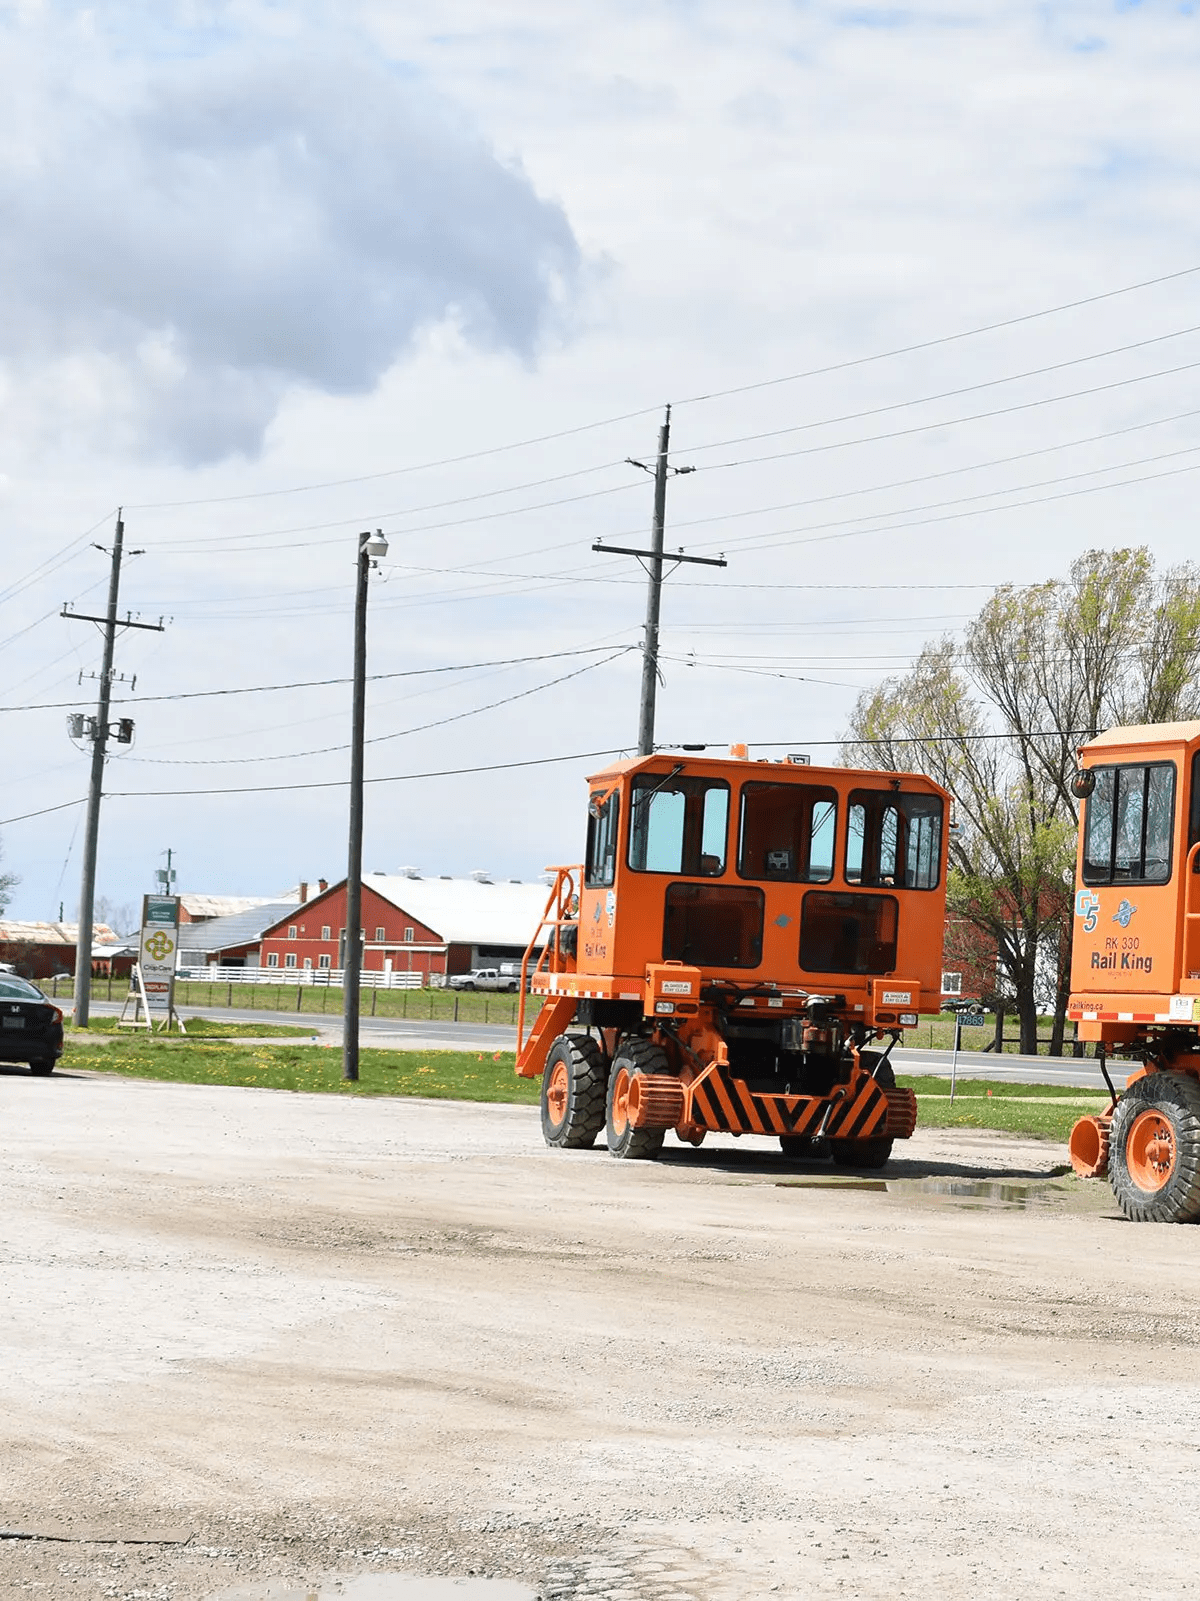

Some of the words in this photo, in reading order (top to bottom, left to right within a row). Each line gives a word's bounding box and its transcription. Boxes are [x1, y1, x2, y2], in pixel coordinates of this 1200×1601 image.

[1105, 937, 1118, 949] RK
[1121, 937, 1140, 950] 330
[1090, 951, 1117, 969] Rail
[1120, 952, 1153, 973] King
[1069, 1000, 1103, 1012] railking.ca
